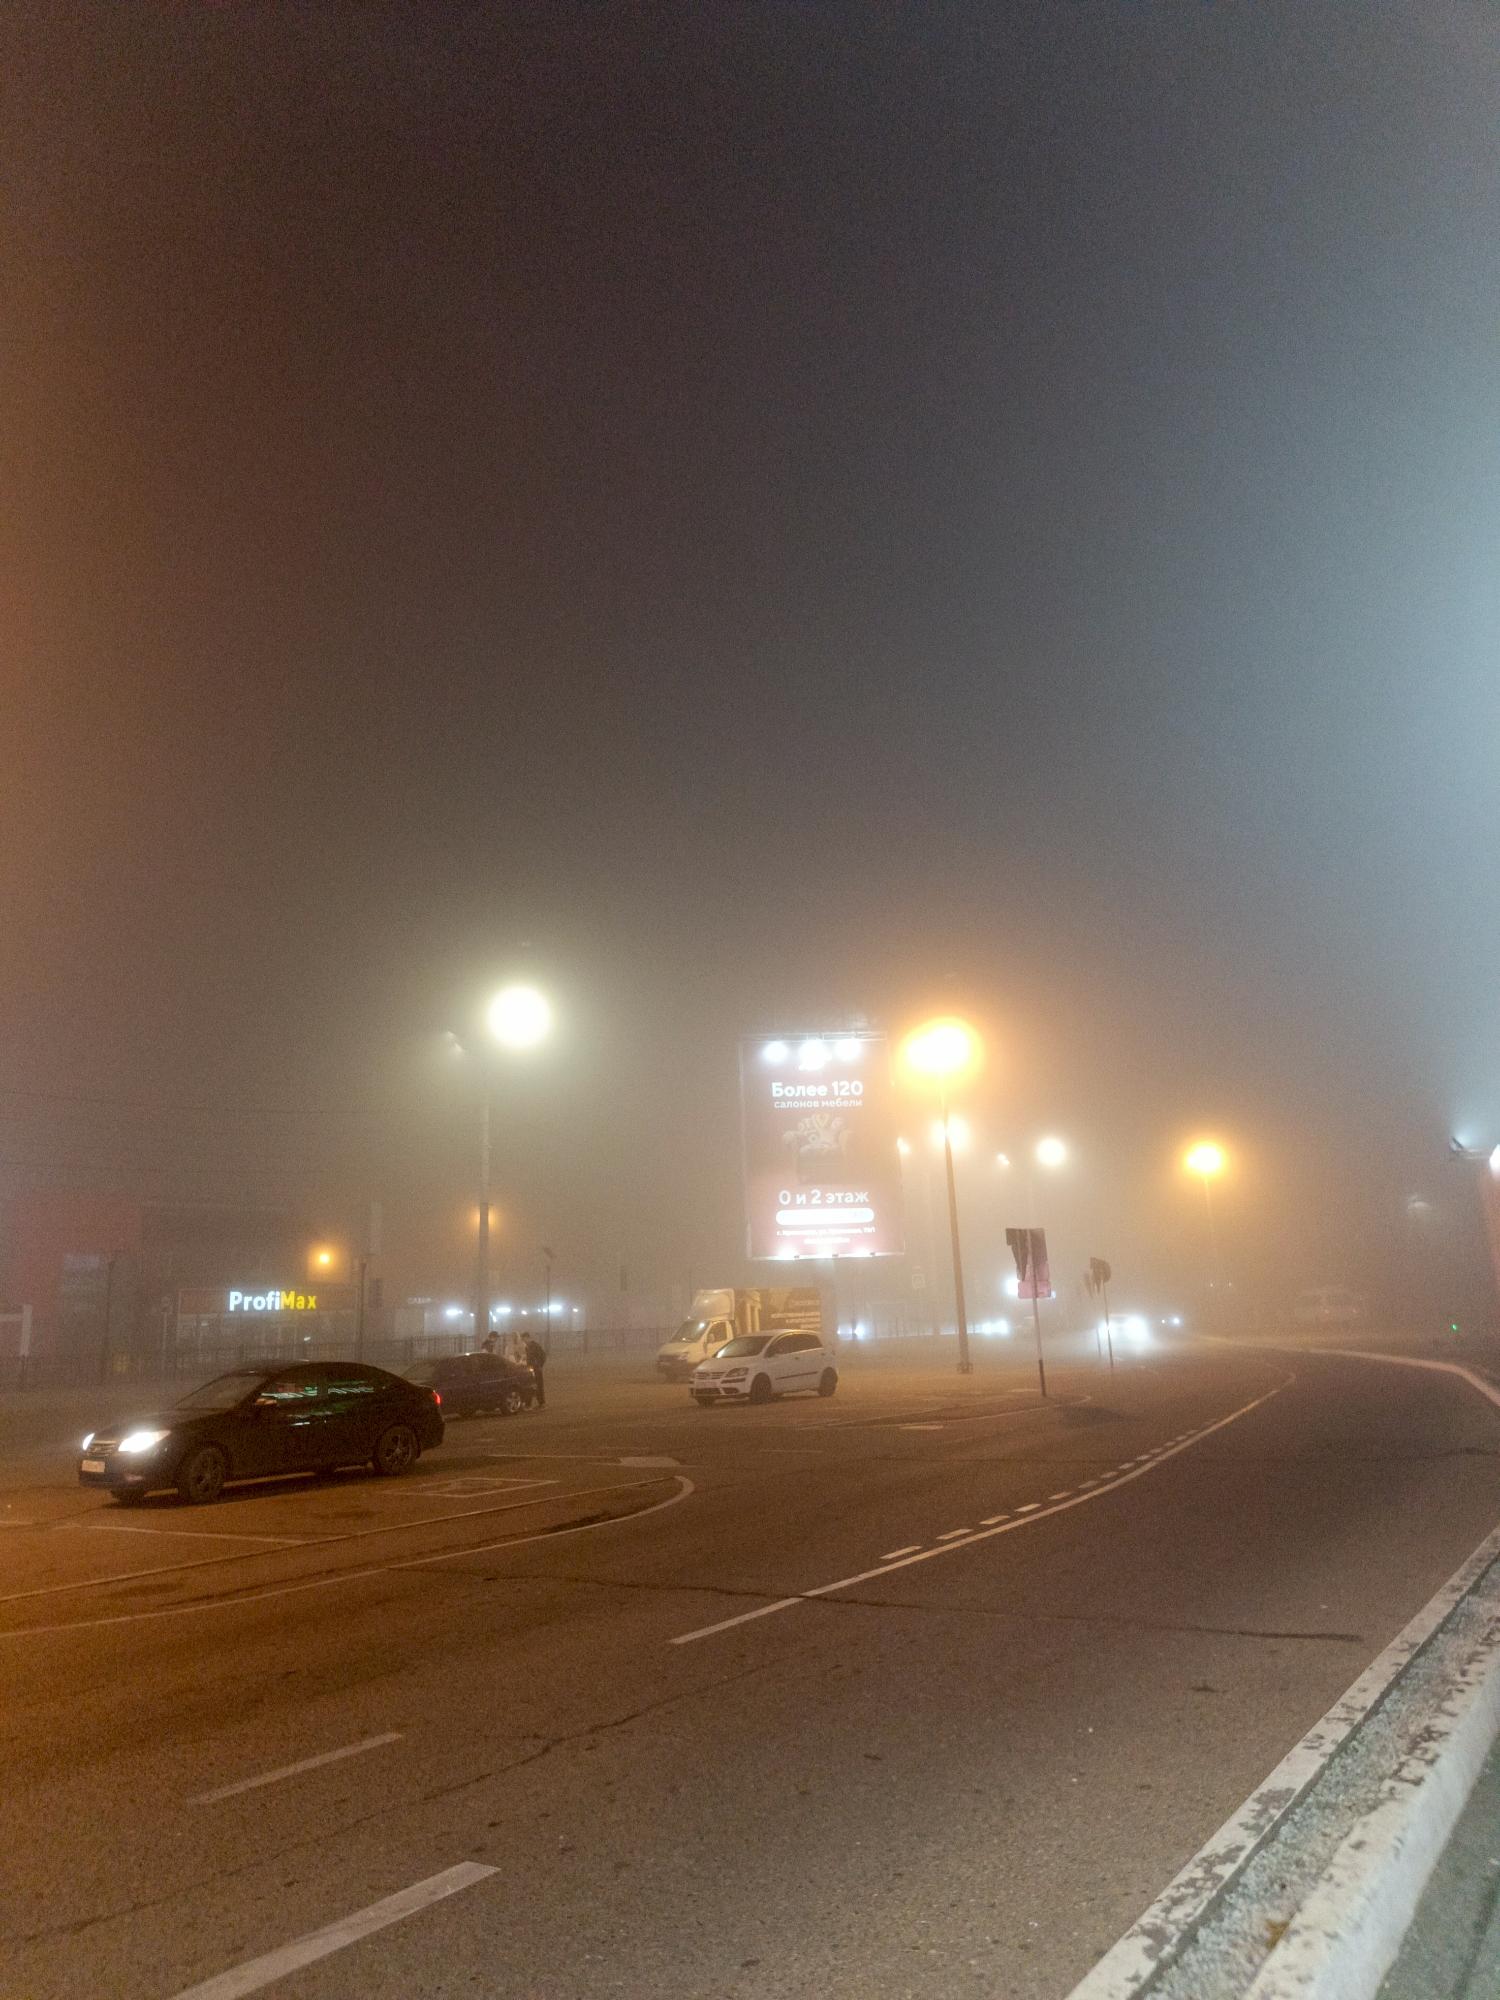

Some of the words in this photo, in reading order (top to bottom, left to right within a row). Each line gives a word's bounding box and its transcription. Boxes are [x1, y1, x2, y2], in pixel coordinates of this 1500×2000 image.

[771, 1081, 828, 1097] Более
[832, 1080, 864, 1096] 120
[774, 1100, 820, 1109] салонов
[821, 1098, 864, 1108] мебели
[796, 1193, 807, 1204] и
[810, 1188, 822, 1204] 2
[825, 1191, 870, 1204] этаж
[229, 1290, 317, 1312] ProfiMax
